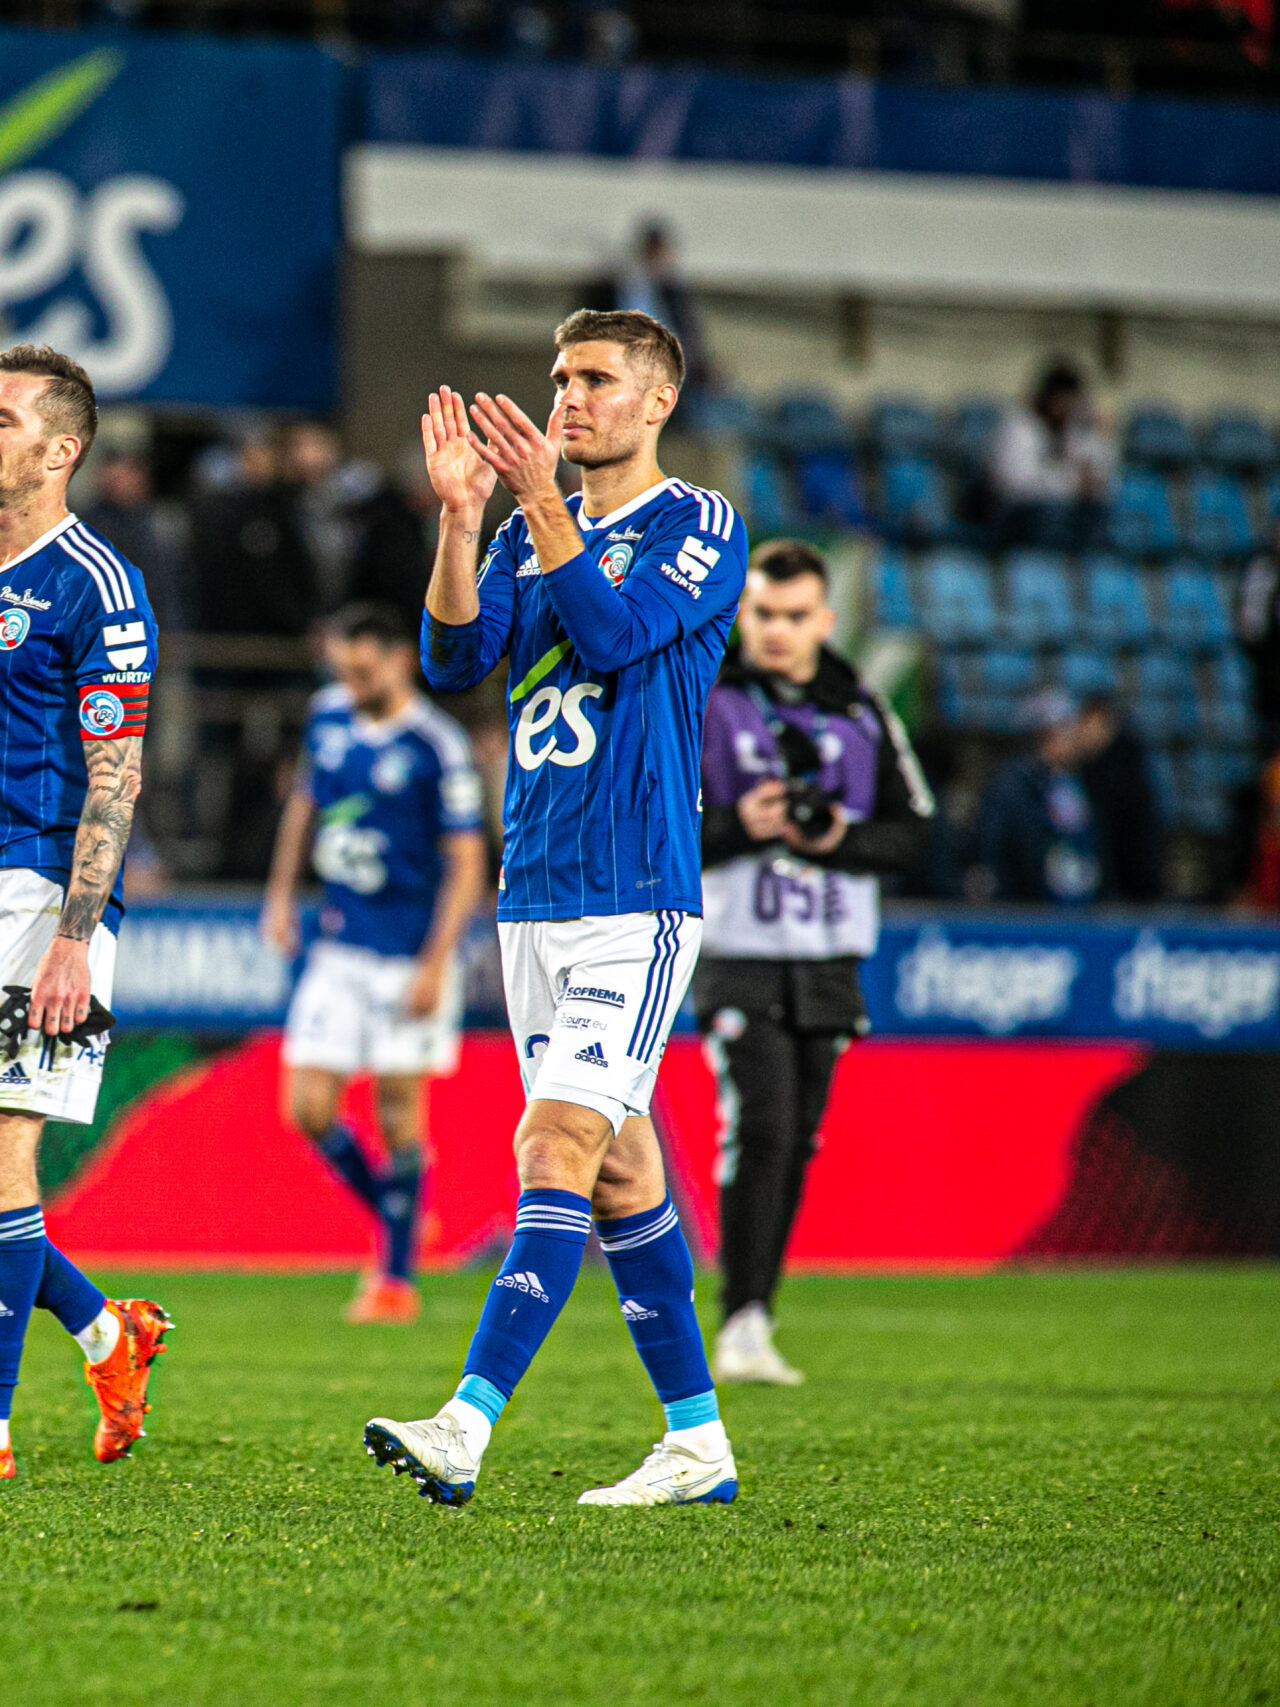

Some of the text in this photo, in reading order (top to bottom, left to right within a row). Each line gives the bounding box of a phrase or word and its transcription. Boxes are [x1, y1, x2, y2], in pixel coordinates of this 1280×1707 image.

[567, 986, 626, 1005] SOPREMA
[574, 1052, 609, 1069] adidas
[496, 1278, 549, 1304] adidas
